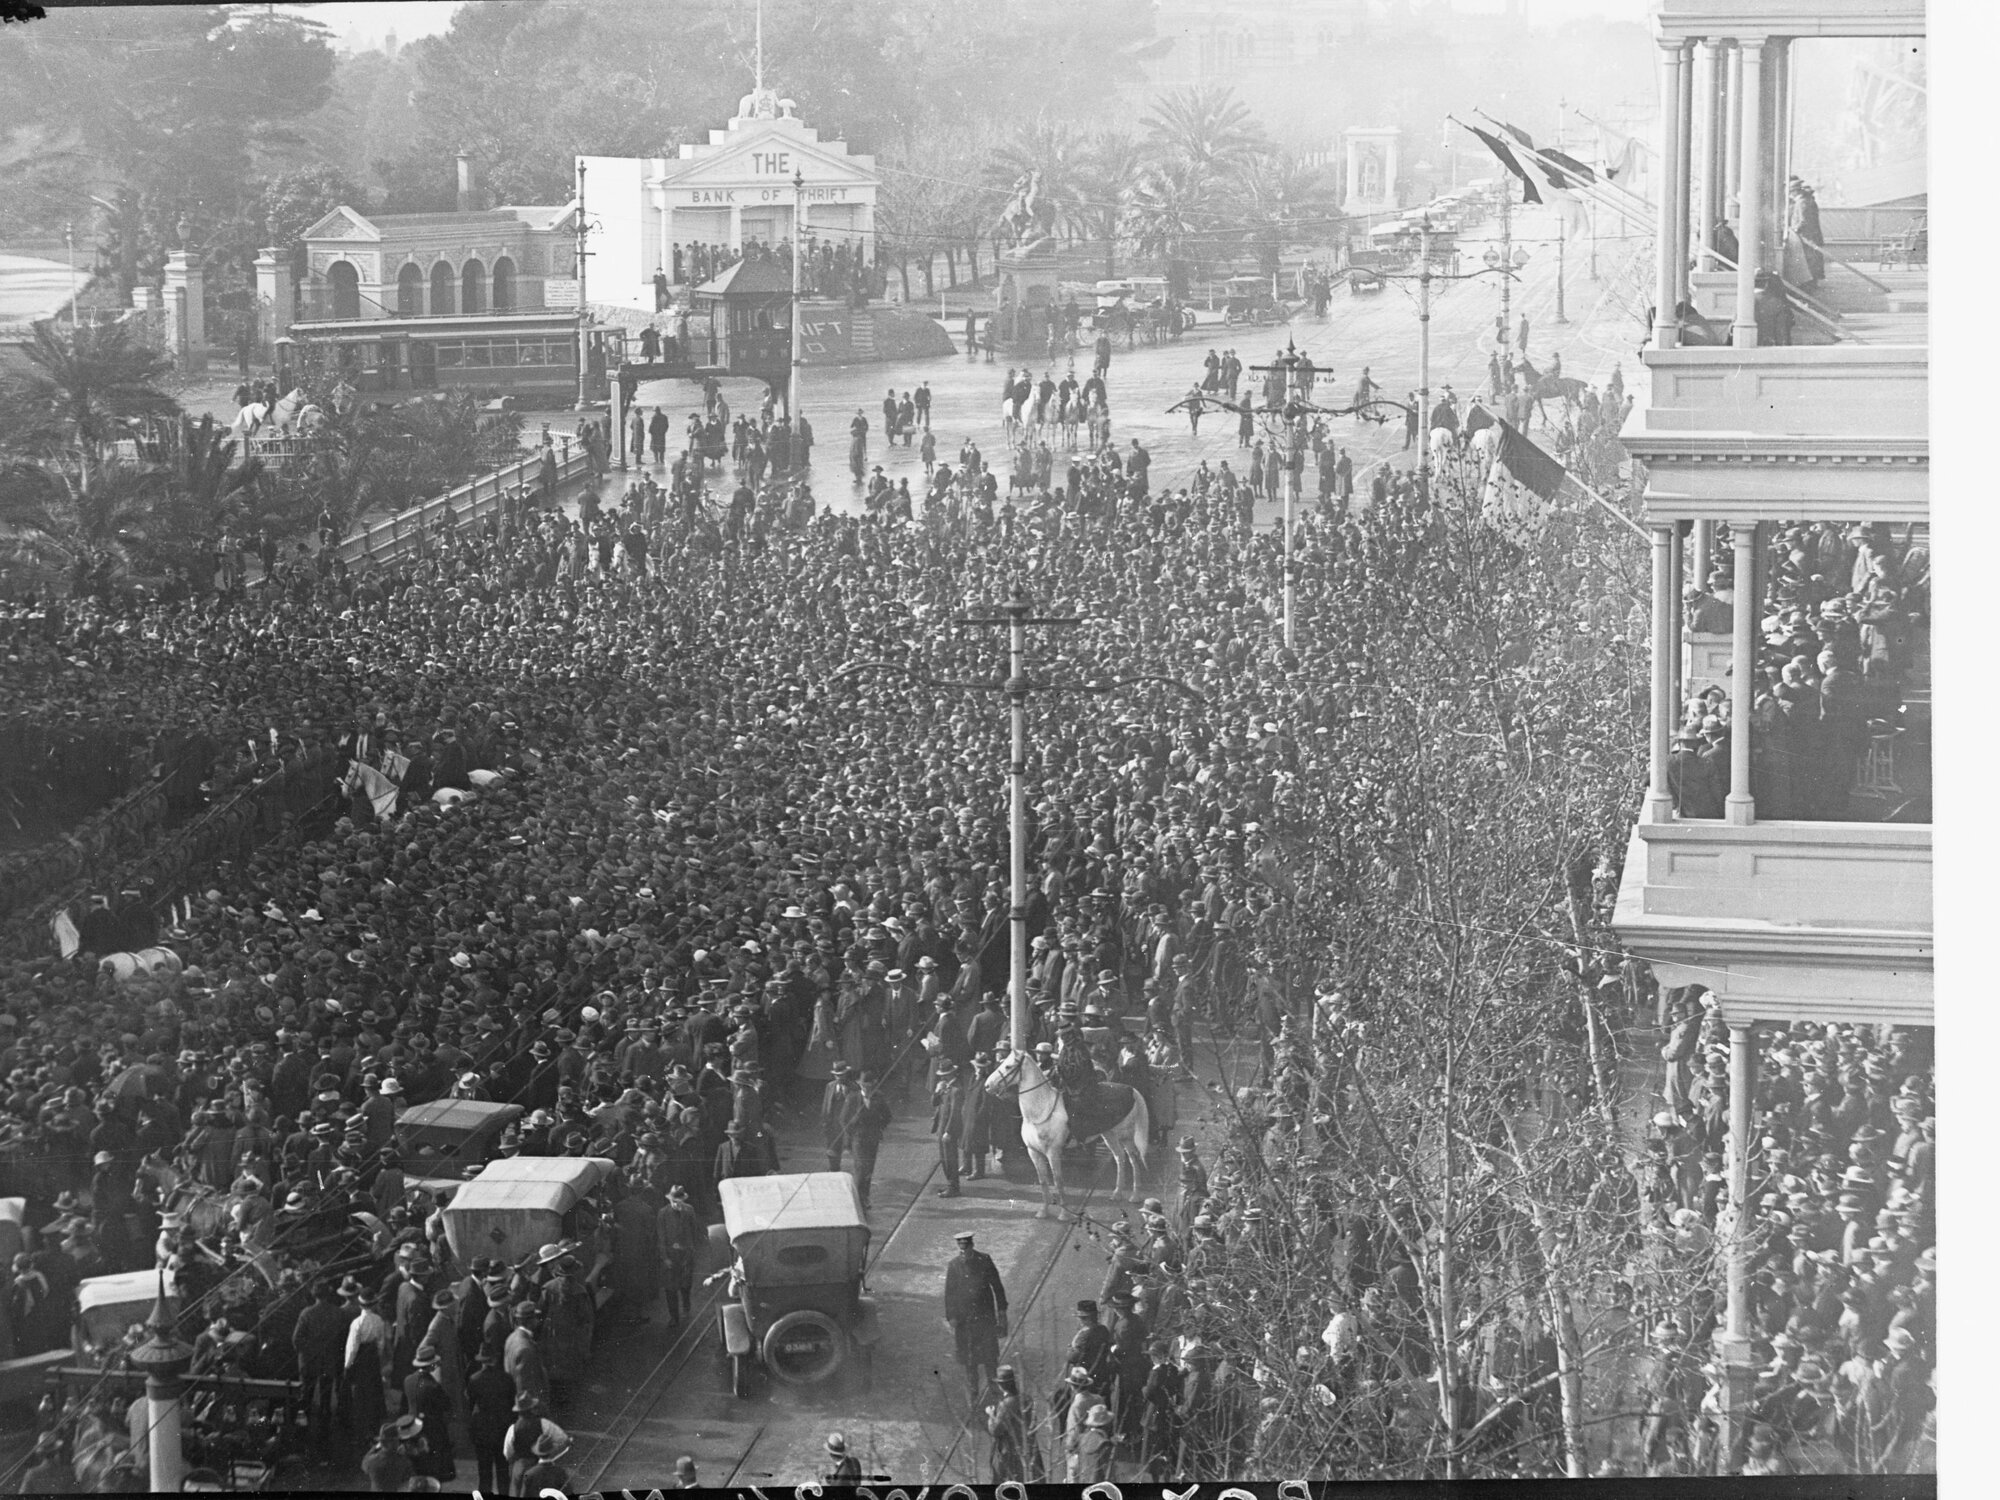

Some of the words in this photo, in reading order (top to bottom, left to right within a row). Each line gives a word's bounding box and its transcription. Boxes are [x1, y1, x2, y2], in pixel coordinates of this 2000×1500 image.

[752, 153, 790, 174] THE
[692, 191, 735, 203] BANK
[761, 189, 781, 201] OF
[800, 188, 848, 201] THRIFT
